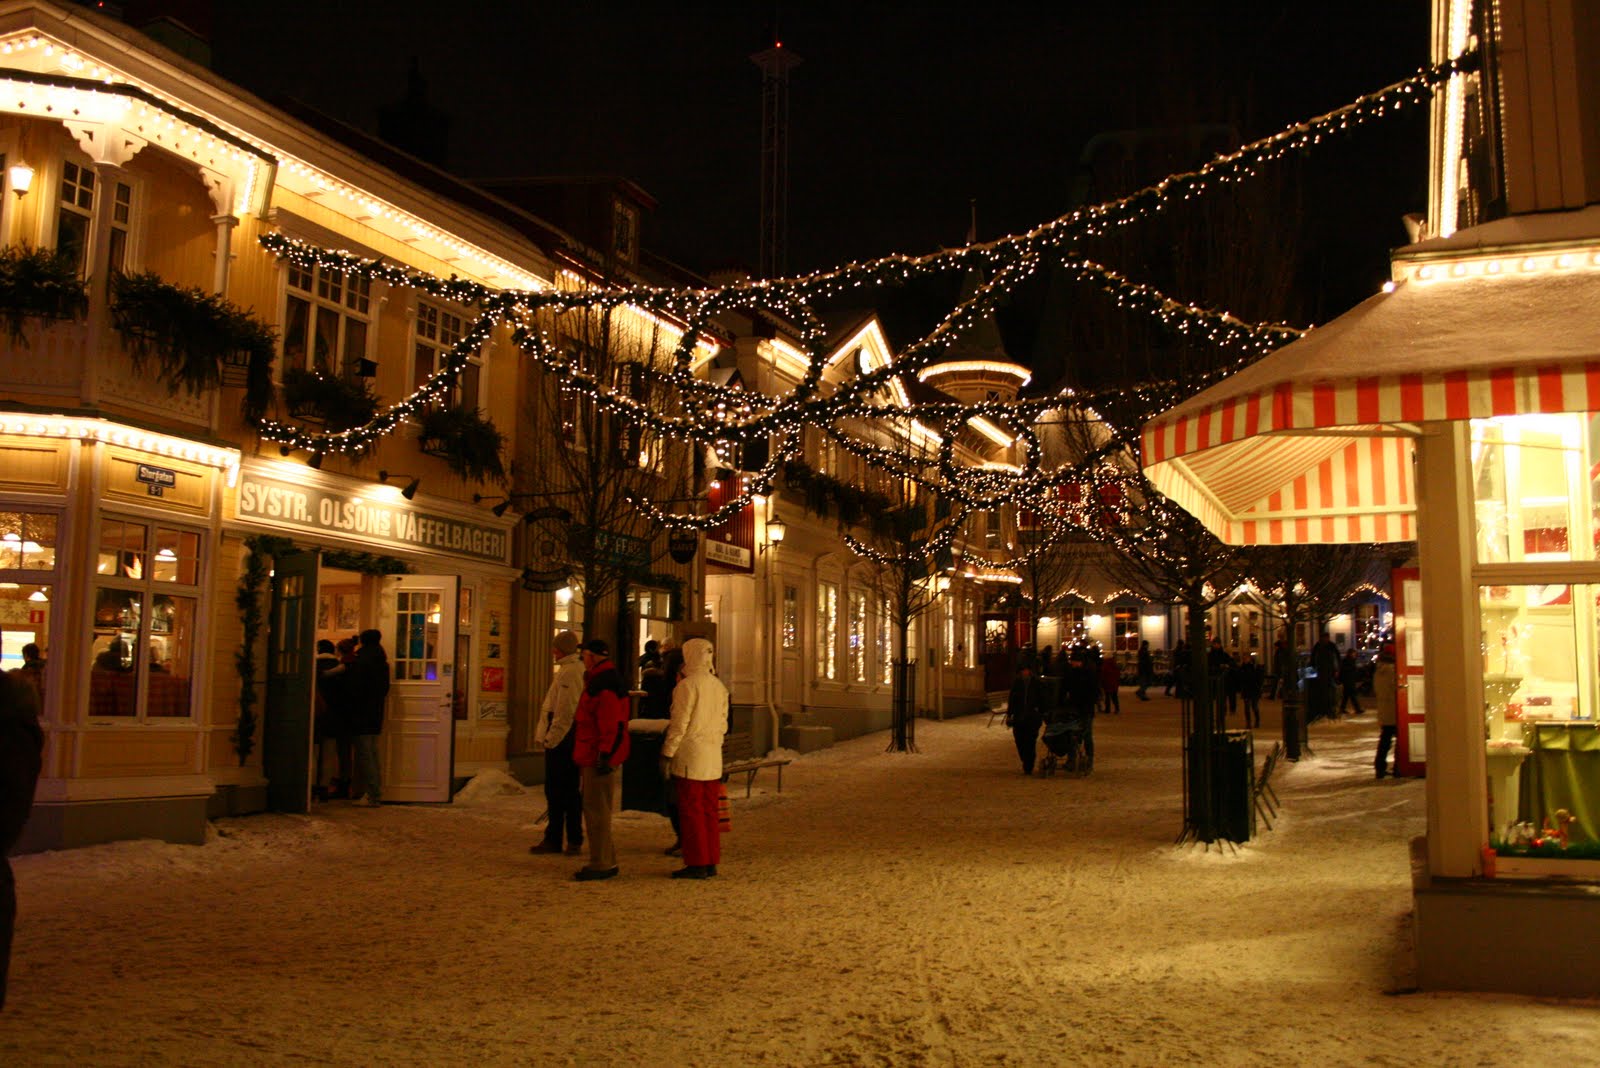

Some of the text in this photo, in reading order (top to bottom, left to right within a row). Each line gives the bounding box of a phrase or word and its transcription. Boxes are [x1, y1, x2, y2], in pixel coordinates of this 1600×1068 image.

[140, 466, 174, 483] Storgatan
[241, 482, 505, 559] SYSTR. OLSONS VÅFFELBAGERI
